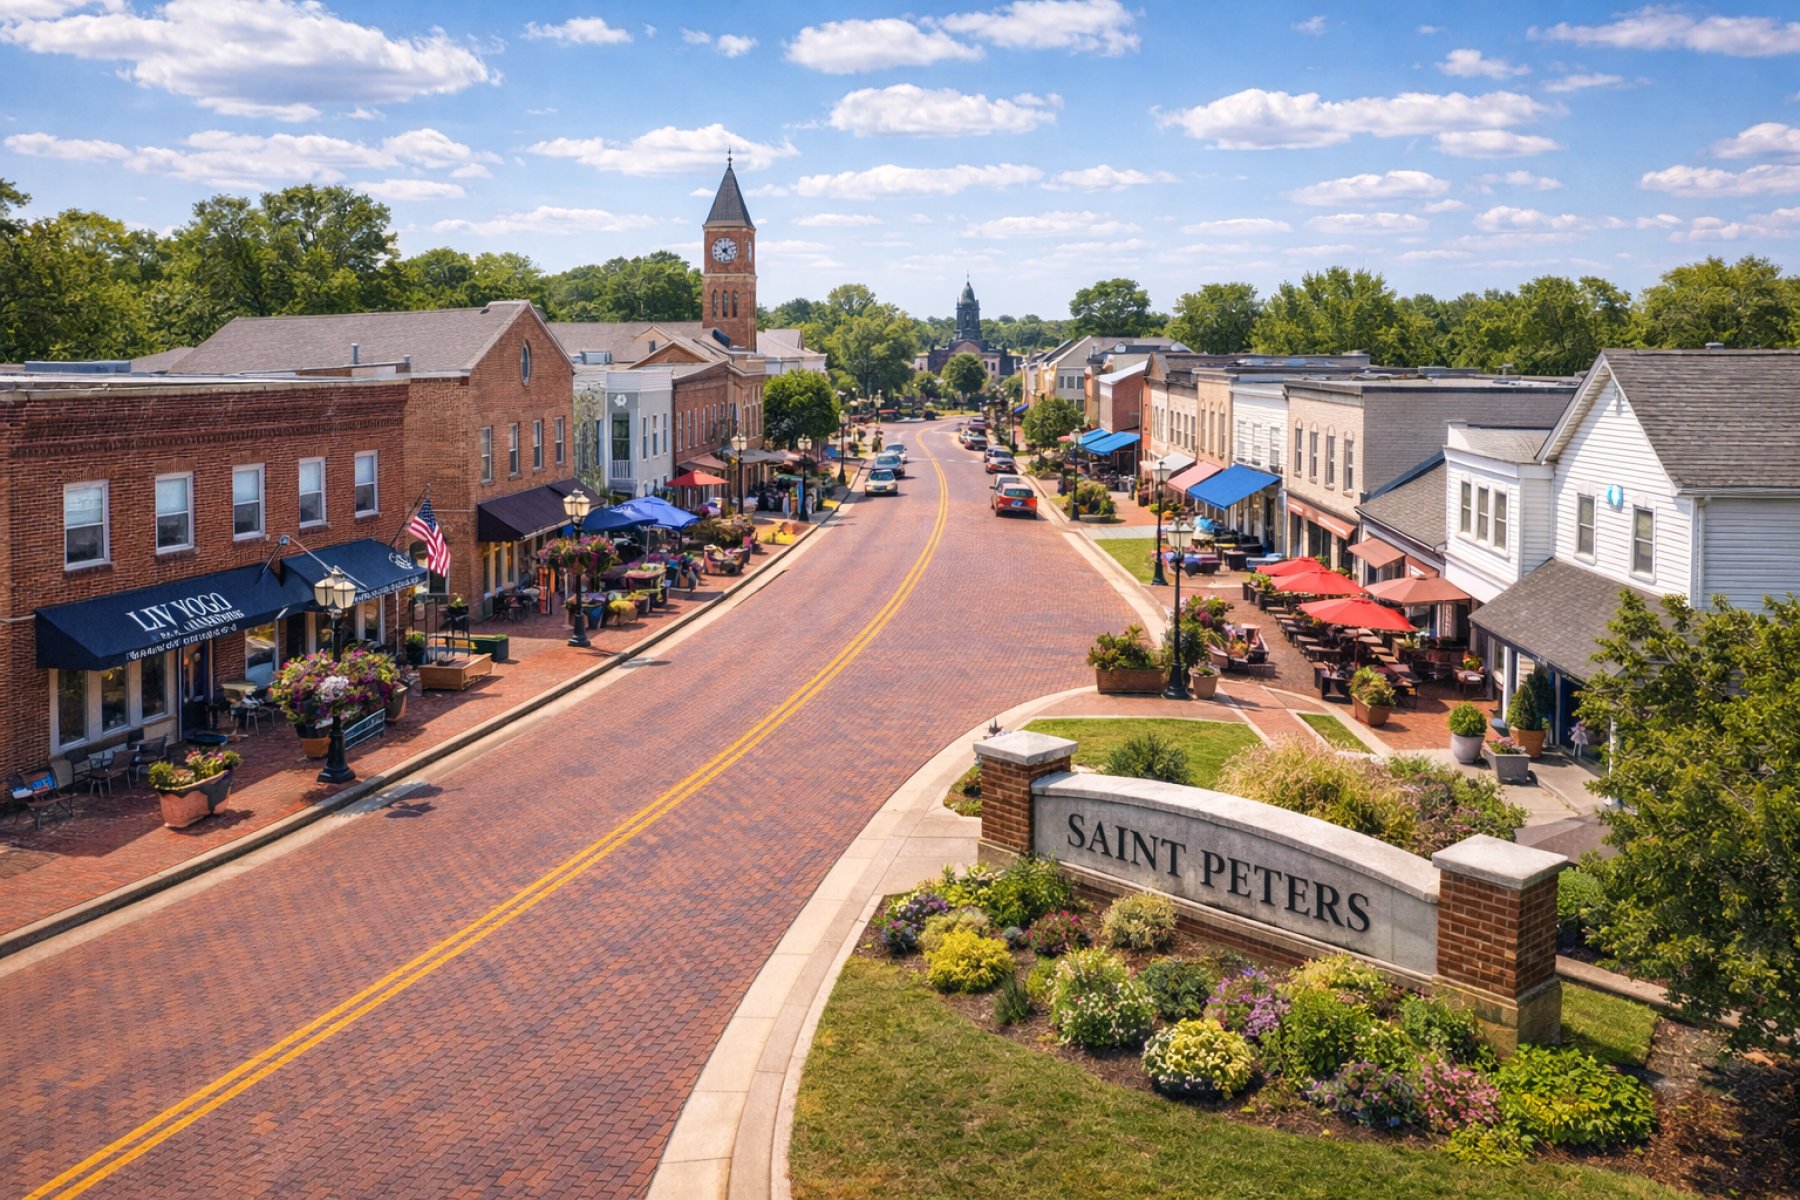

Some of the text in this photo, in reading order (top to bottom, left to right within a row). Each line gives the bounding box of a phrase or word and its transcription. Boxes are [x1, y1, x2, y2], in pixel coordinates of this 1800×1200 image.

[125, 604, 179, 632] LIV
[1067, 813, 1370, 933] SAINT PETERS
